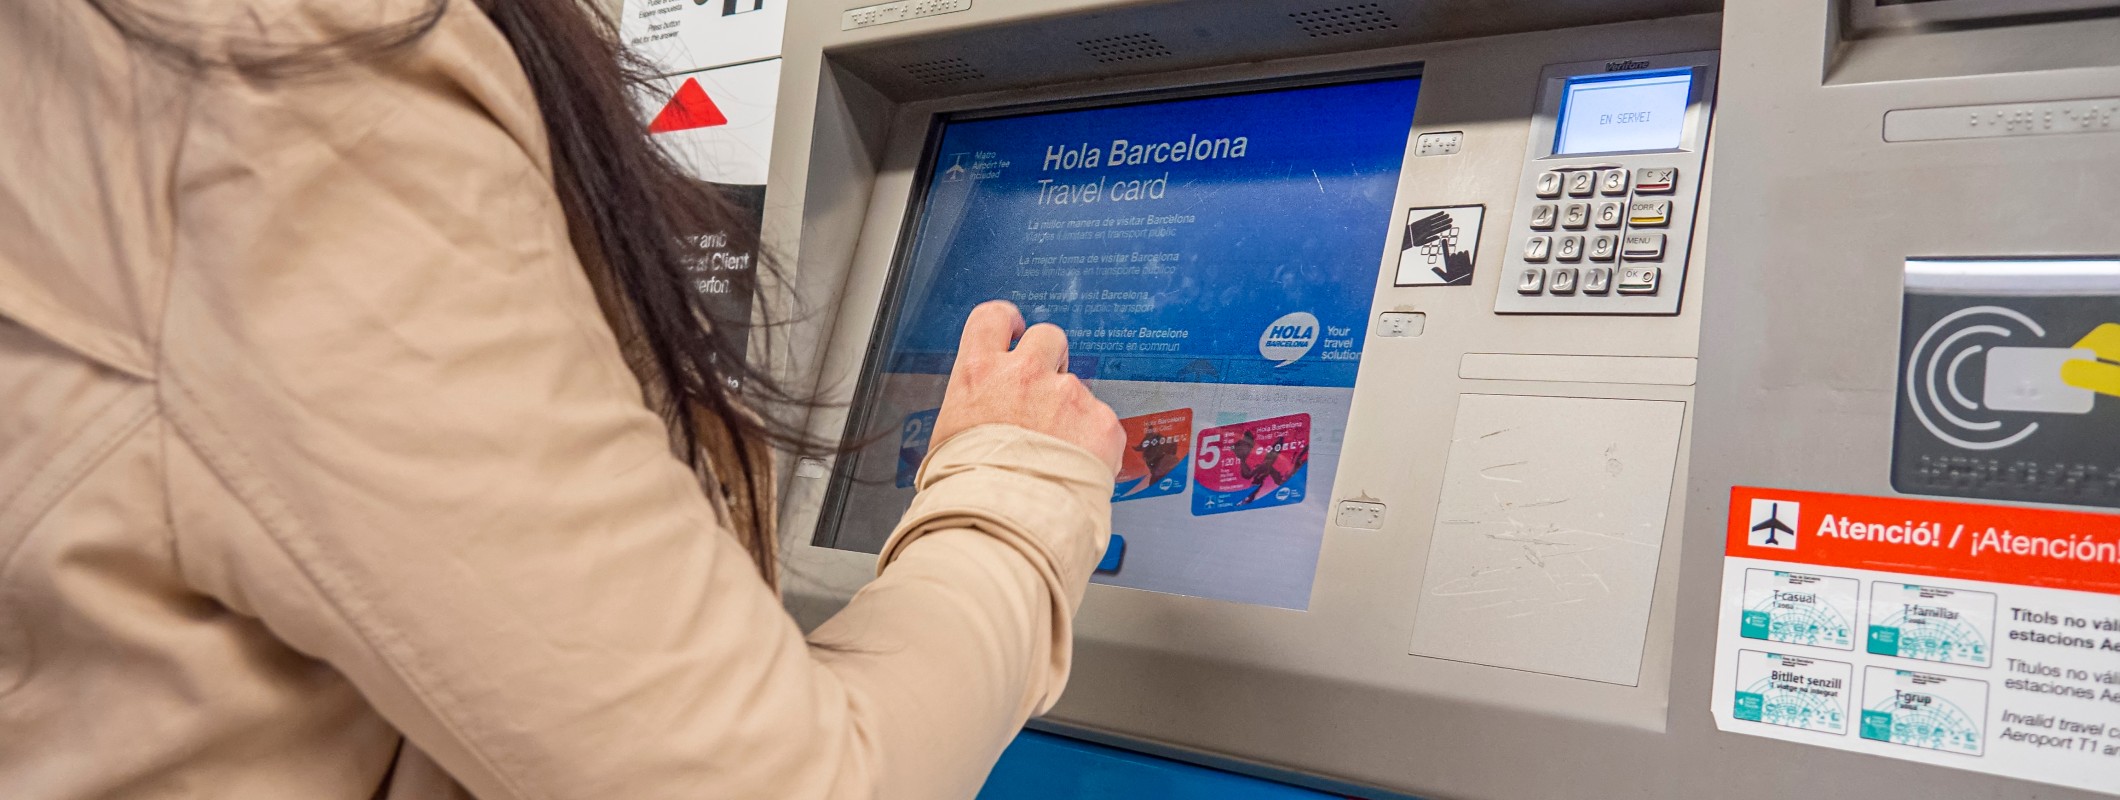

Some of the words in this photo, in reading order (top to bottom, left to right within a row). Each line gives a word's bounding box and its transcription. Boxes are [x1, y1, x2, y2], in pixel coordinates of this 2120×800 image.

[1600, 114, 1612, 125] EN
[1617, 111, 1652, 124] SERVEI
[1042, 143, 1101, 171] Hola
[1107, 133, 1249, 167] Barcelona
[1037, 176, 1106, 206] Travel
[1111, 172, 1169, 201] card
[1545, 177, 1553, 190] 1
[1576, 175, 1587, 190] 2
[1608, 173, 1619, 189] 3
[1537, 208, 1547, 222] 4
[1568, 206, 1580, 222] 5
[1602, 205, 1613, 220] 6
[1632, 203, 1654, 211] CORR
[1028, 220, 1038, 230] La
[1066, 218, 1101, 228] manera
[1103, 217, 1115, 227] de
[1116, 216, 1145, 226] visitar
[1147, 214, 1196, 225] Barcelona
[1532, 240, 1542, 255] 7
[1563, 239, 1574, 255] 8
[1597, 238, 1608, 254] 9
[1626, 237, 1650, 245] MENU
[712, 252, 750, 271] Client
[1019, 255, 1030, 265] La
[1059, 254, 1086, 264] forma
[1087, 254, 1099, 264] de
[1101, 253, 1129, 263] visitar
[1131, 251, 1180, 262] Barcelona
[1556, 271, 1567, 287] 0
[1626, 270, 1638, 278] OK
[1011, 290, 1028, 300] The
[1029, 290, 1048, 300] best
[1080, 290, 1099, 300] visit
[1101, 289, 1149, 301] Barcelona
[1094, 327, 1105, 337] de
[1108, 327, 1137, 338] visiter
[1139, 327, 1188, 338] Barcelone
[1269, 326, 1313, 339] HOLA
[1327, 325, 1351, 337] Your
[1079, 340, 1124, 351] transports
[1126, 341, 1137, 350] en
[1139, 341, 1180, 351] commun
[1266, 340, 1308, 348] BARCELONA
[1324, 338, 1354, 348] travel
[903, 418, 922, 448] 2
[1198, 434, 1221, 470] 5
[1816, 513, 1941, 547] Atenció!
[1947, 524, 1964, 549] /
[1773, 589, 1817, 604] T-casual
[1903, 603, 1960, 620] T-familiar
[2010, 607, 2059, 625] Títols
[2064, 616, 2086, 628] no
[2008, 629, 2094, 649] estacions
[2006, 657, 2061, 677] Títulos
[2066, 668, 2088, 681] no
[1771, 670, 1804, 684] Bitllet
[1807, 677, 1842, 689] senzill
[2004, 678, 2095, 700] estaciones
[1895, 689, 1932, 706] T-grup
[2001, 709, 2056, 729] Invalid
[2058, 718, 2105, 736] travel
[2000, 727, 2073, 748] Aeroport
[2079, 737, 2098, 753] T1
